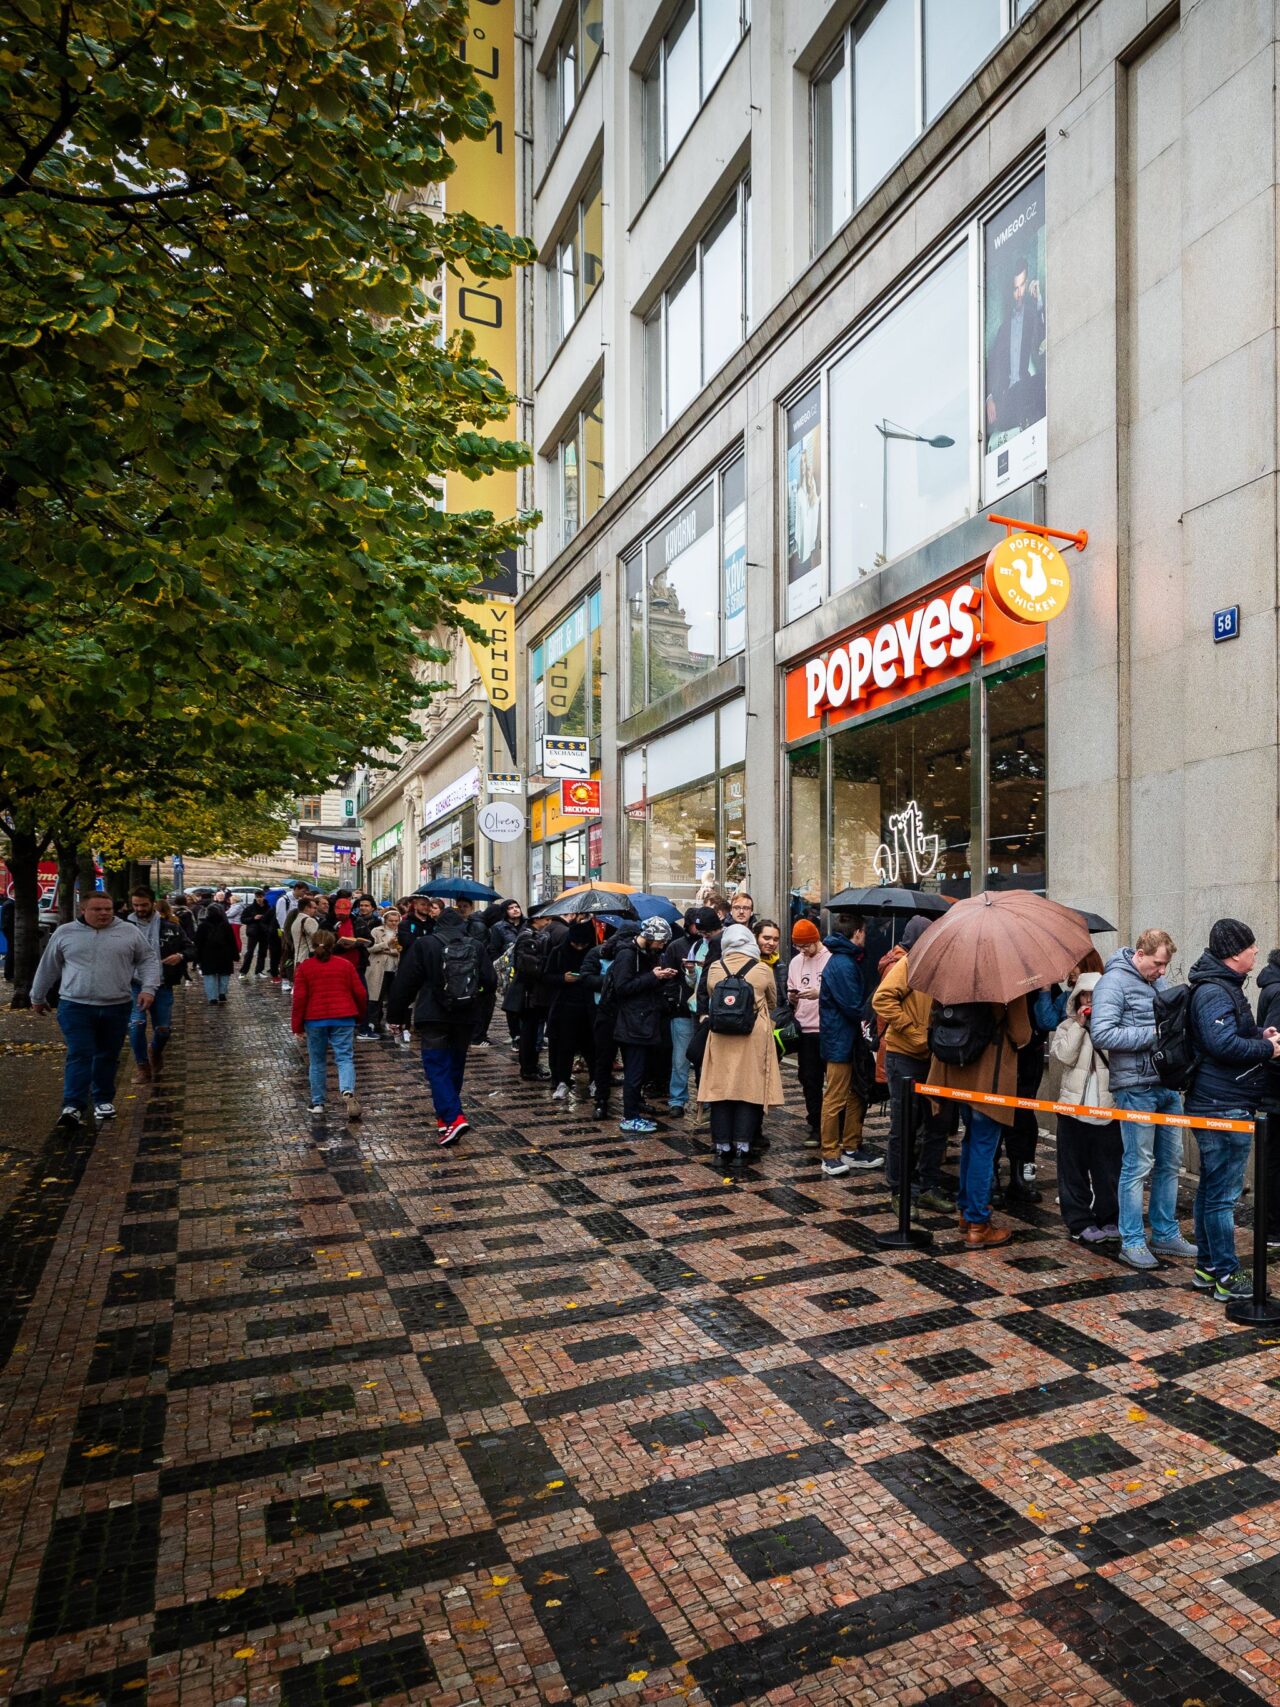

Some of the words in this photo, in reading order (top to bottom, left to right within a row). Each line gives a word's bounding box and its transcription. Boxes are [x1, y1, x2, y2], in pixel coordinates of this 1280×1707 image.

[993, 201, 1037, 250] WMEGO.CZ
[1008, 537, 1056, 561] POPEYES
[1007, 588, 1057, 613] CHICKEN
[1217, 614, 1232, 633] 58
[490, 608, 509, 701] VCHOD
[549, 749, 585, 758] EXCHANGE
